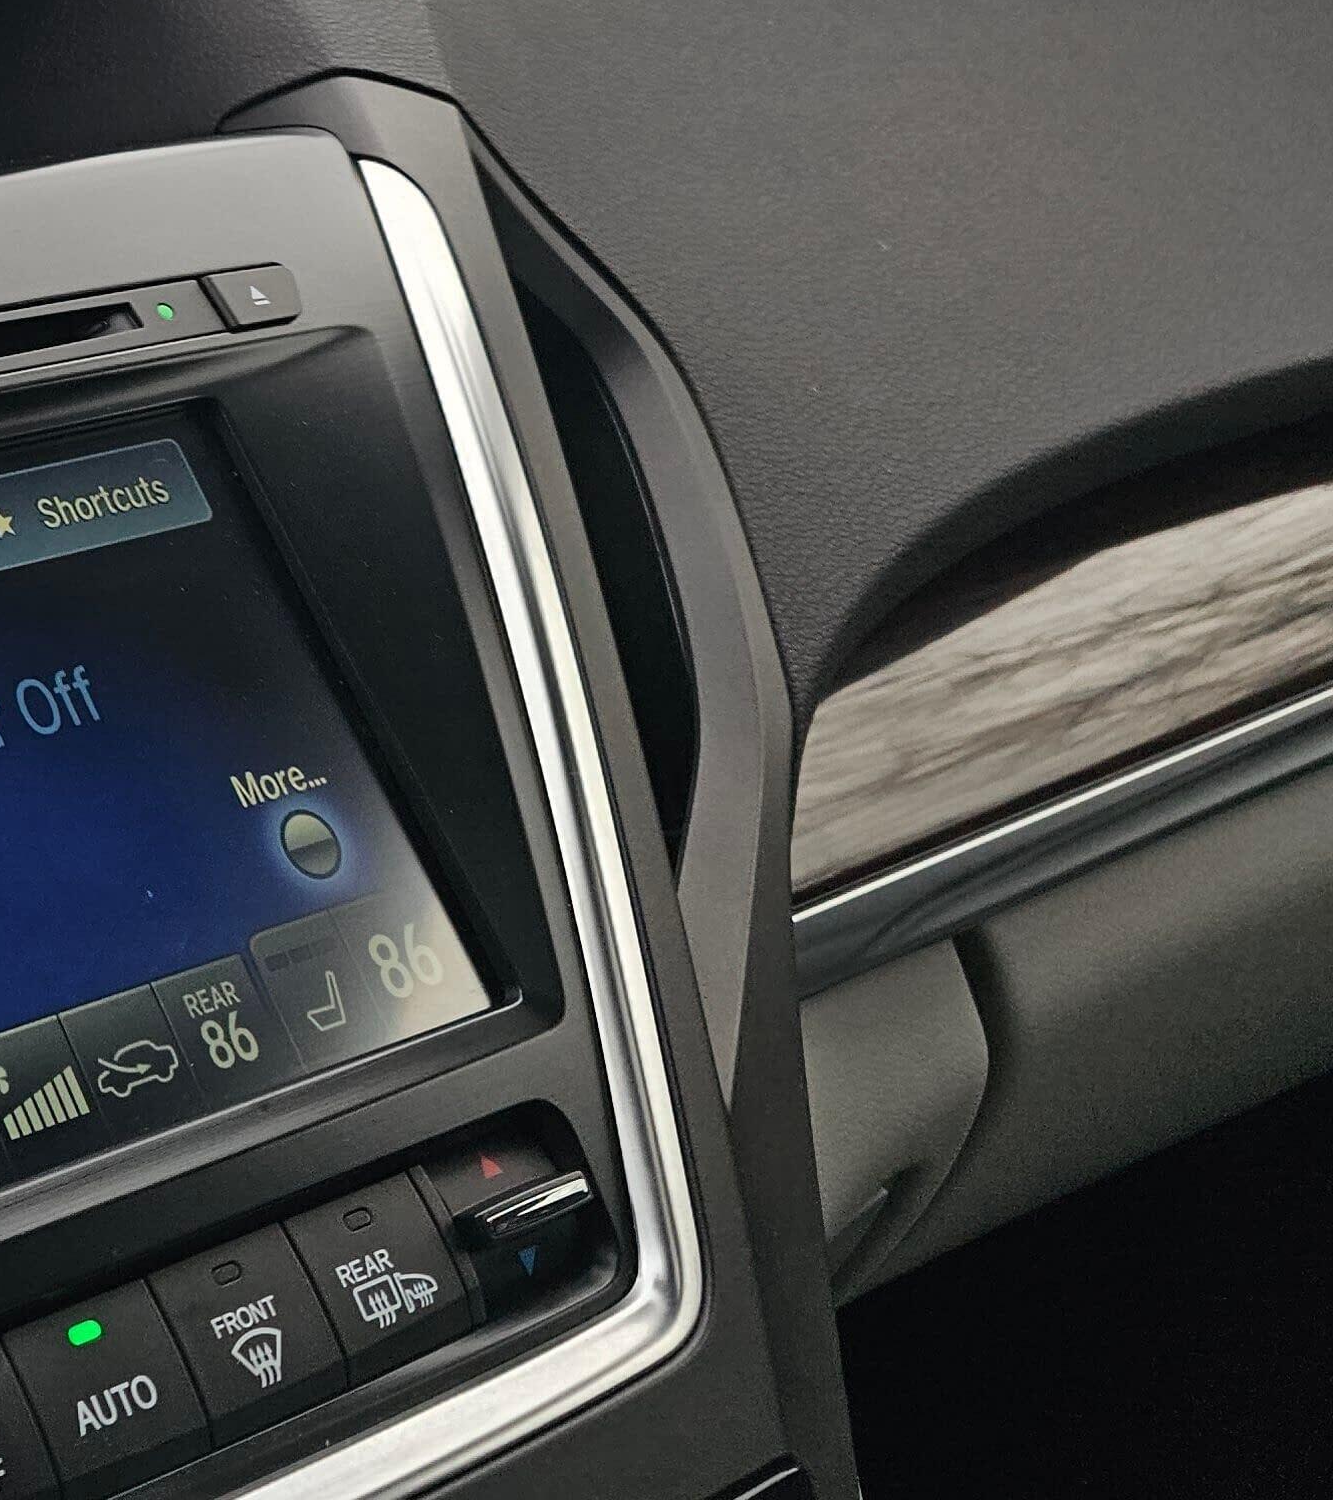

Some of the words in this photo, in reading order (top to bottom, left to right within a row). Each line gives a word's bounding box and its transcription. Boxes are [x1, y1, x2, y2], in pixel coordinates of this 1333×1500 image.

[36, 475, 171, 529] Shortcuts
[15, 664, 102, 735] Off
[367, 922, 445, 1000] 86
[181, 980, 242, 1020] REAR
[199, 1010, 260, 1071] 86
[334, 1248, 394, 1288] REAR
[209, 1294, 278, 1340] FRONT
[75, 1374, 158, 1437] AUTO
